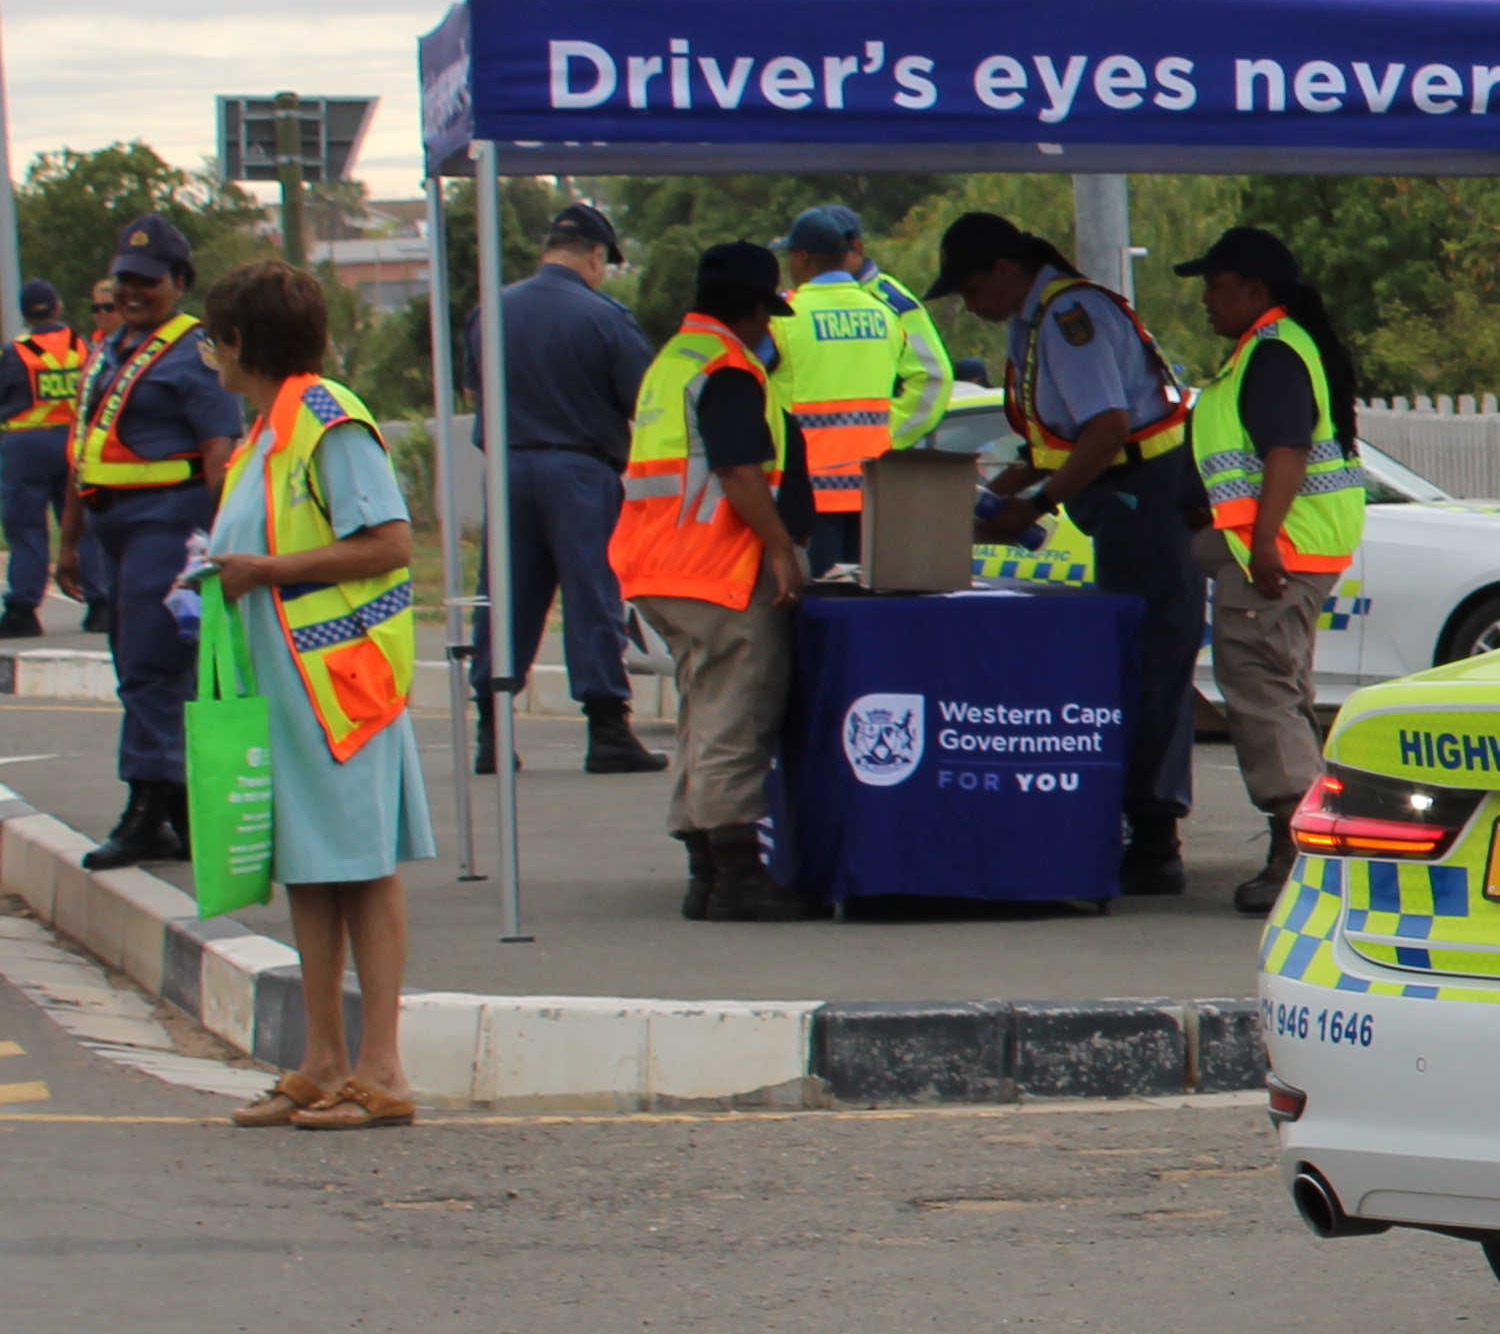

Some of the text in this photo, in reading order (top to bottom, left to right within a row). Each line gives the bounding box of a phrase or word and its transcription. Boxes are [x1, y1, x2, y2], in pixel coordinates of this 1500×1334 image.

[548, 39, 938, 111] Driver's
[974, 52, 1197, 125] eyes
[813, 311, 886, 340] TRAFFIC
[938, 700, 1122, 728] Western Cape
[938, 728, 1103, 753] Government
[938, 770, 1080, 792] FOR YOU
[1277, 1002, 1310, 1040] 946
[1317, 1008, 1374, 1047] 1646
